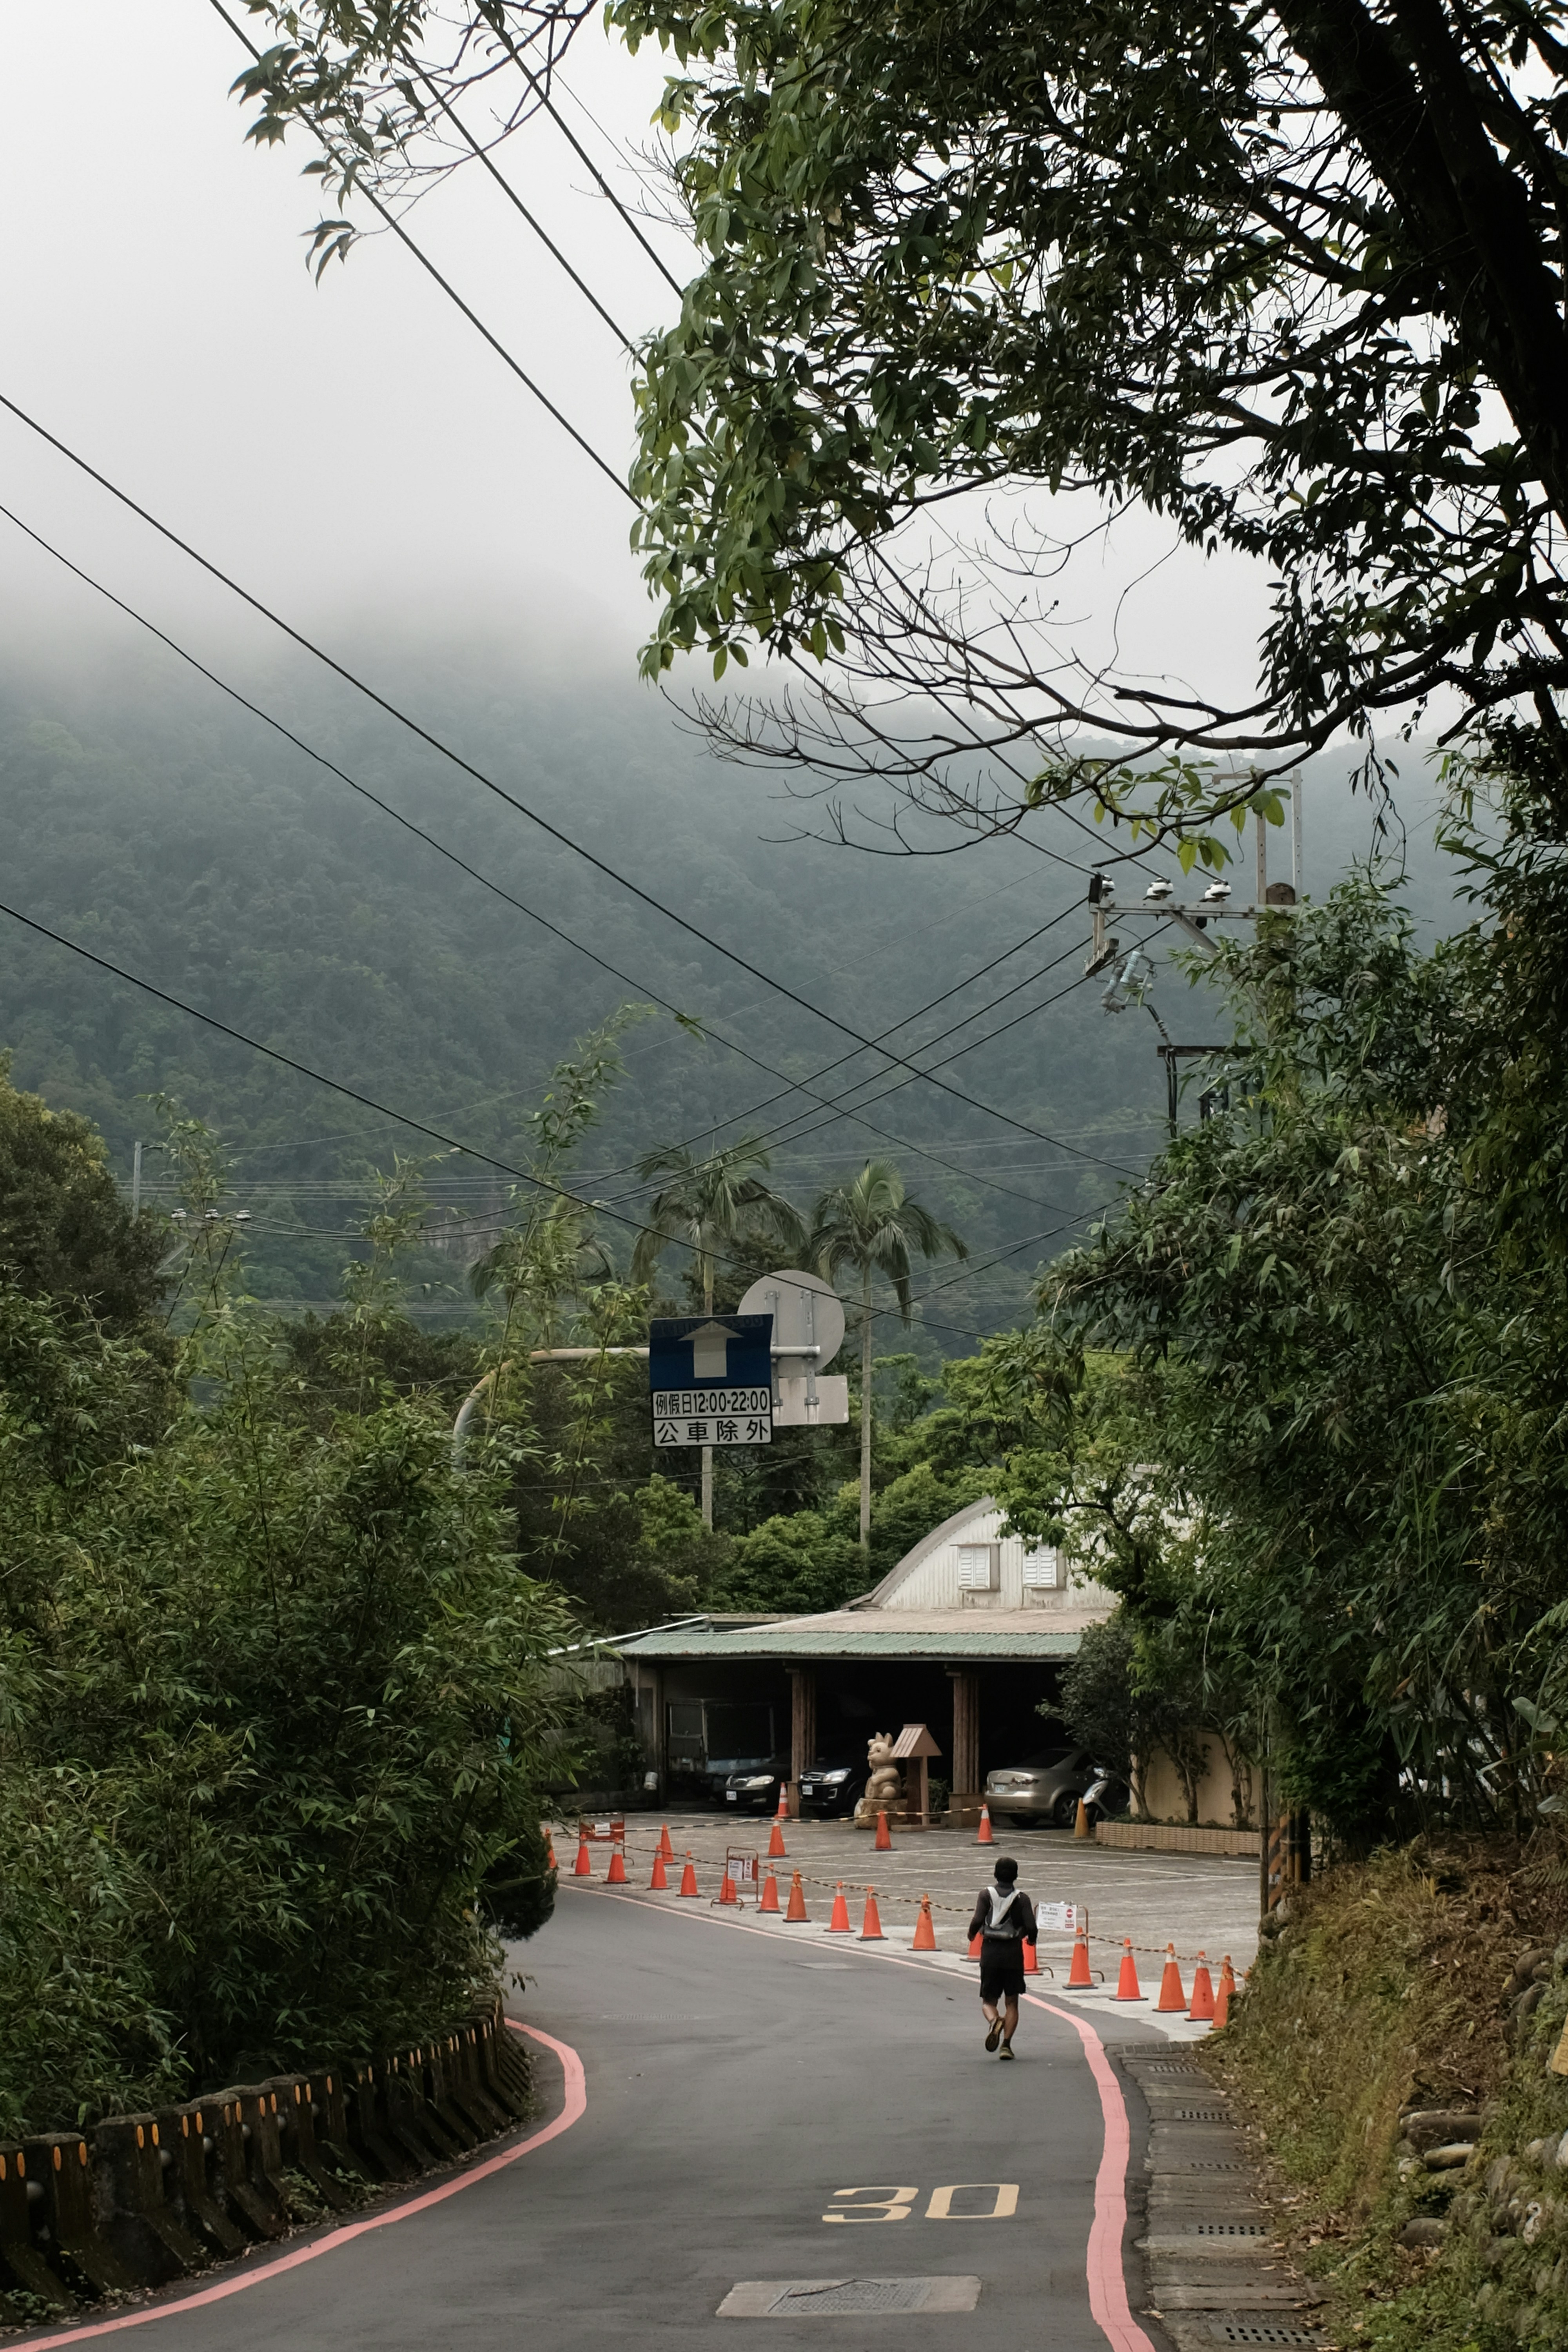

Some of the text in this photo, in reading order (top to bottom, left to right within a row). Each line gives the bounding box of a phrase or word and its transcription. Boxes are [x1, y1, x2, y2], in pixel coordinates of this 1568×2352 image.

[657, 1419, 768, 1443] 公車除外
[822, 2183, 1020, 2223] 30
